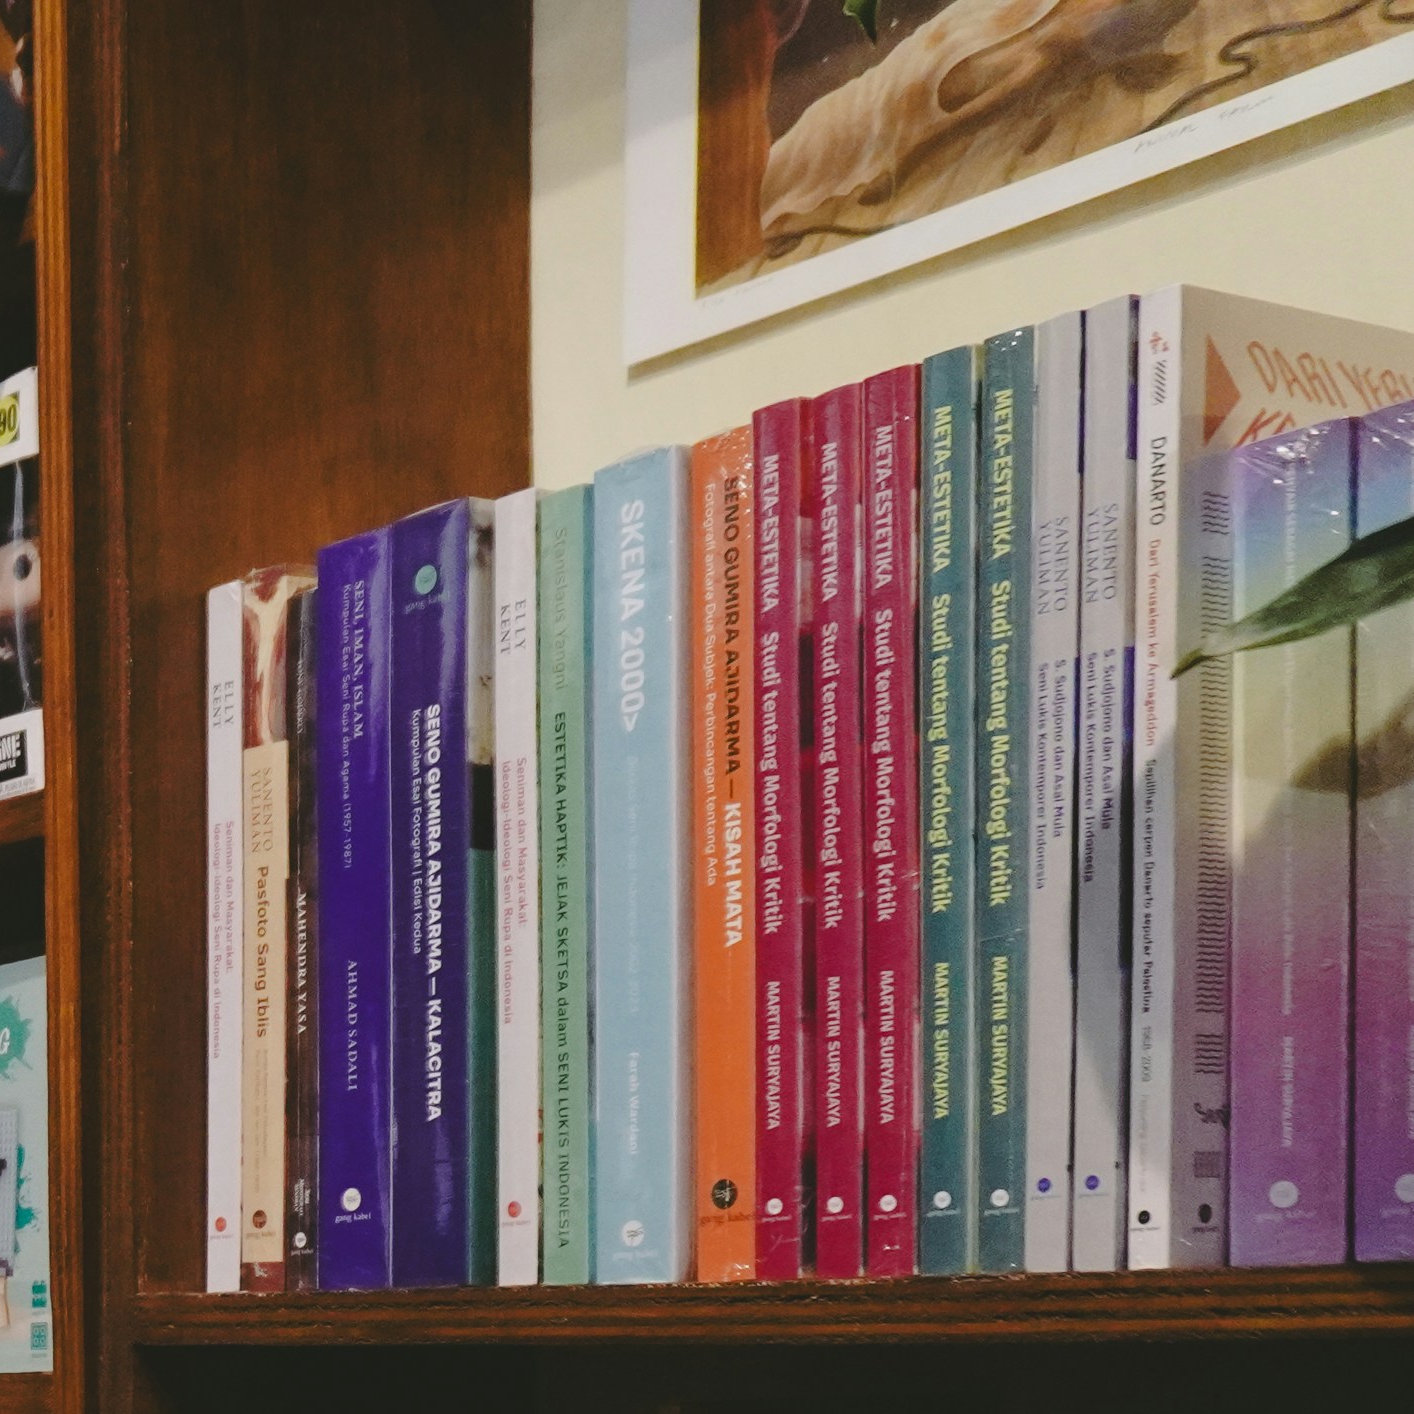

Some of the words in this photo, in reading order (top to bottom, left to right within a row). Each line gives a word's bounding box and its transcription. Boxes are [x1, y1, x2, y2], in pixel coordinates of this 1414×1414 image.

[1247, 341, 1348, 408] DARI
[874, 425, 893, 589] META-ESTETIKA
[933, 405, 953, 573] META-ESTETIKA
[991, 389, 1014, 559] META-ESTETIKA
[1150, 436, 1167, 525] DANARTO
[724, 479, 741, 542] SENO
[761, 455, 780, 613] META-ESTETIKA
[820, 442, 838, 602] META-ESTETIKA
[620, 500, 645, 621] SKENA
[724, 547, 742, 643] GUMIRA
[875, 608, 895, 664] Studi
[933, 593, 952, 651] Studi
[991, 581, 1011, 639] Studi
[762, 631, 781, 686] Studi
[821, 622, 840, 677] Studi
[353, 686, 364, 738] ISLAM
[724, 649, 743, 775] AJIDARMA
[819, 682, 838, 763] tentang
[872, 669, 892, 753] tentang
[928, 655, 950, 741] tentang
[987, 644, 1009, 730] tentang
[426, 704, 442, 763] SENO
[554, 712, 567, 795] ESTETIKA
[760, 690, 779, 771] tentang
[426, 767, 442, 854] GUMIRA
[820, 768, 842, 866] Morfologi
[873, 758, 896, 858] Morfologi
[928, 746, 951, 847] Morfologi
[987, 735, 1010, 840] Morfologi
[725, 803, 743, 876] KISAH
[760, 775, 783, 873] Morfologi
[257, 866, 269, 938] Pasfoto
[555, 875, 569, 921] JEJAK
[764, 877, 783, 935] Kritik
[824, 871, 842, 929] Kritik
[877, 863, 896, 922] Kritik
[932, 853, 952, 913] Kritik
[990, 845, 1010, 906] Kritik
[426, 859, 442, 974] AJIDARMA
[725, 882, 743, 947] MATA
[254, 944, 269, 991] Sang
[347, 960, 358, 1024] AHMAD
[556, 927, 569, 991] SKETSA
[933, 962, 949, 1024] MARTIN
[992, 956, 1008, 1019] MARTIN
[257, 996, 269, 1038] Iblis
[556, 997, 570, 1047] dalam
[766, 981, 781, 1041] MARTIN
[826, 976, 841, 1037] MARTIN
[879, 970, 894, 1032] MARTIN
[347, 1029, 359, 1090] SADALI
[426, 999, 442, 1121] KALACITRA
[557, 1052, 570, 1093] SENI
[766, 1045, 781, 1130] SURYAJAYA
[826, 1041, 841, 1127] SURYAJAYA
[878, 1035, 894, 1124] SURYAJAYA
[933, 1029, 949, 1119] SURYAJAYA
[991, 1024, 1008, 1115] SURYAJAYA
[557, 1098, 570, 1148] LUKIS
[557, 1154, 571, 1248] INDONESIA
